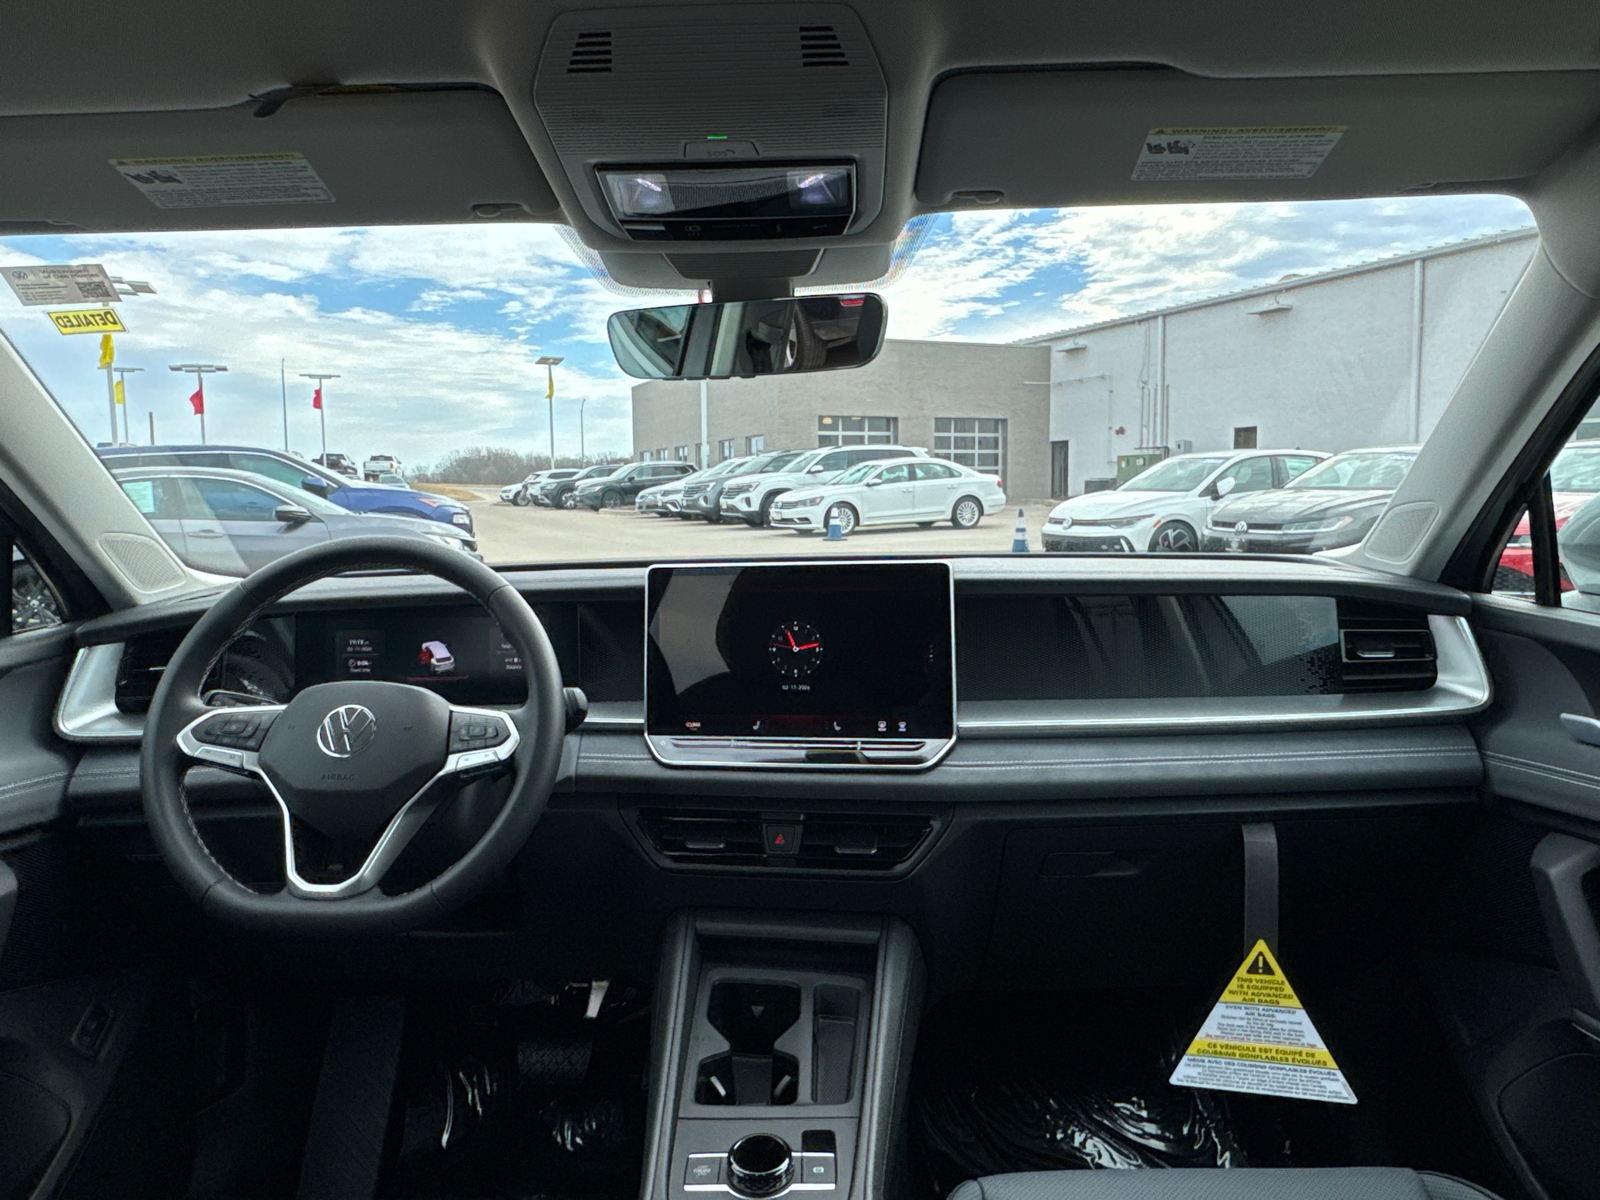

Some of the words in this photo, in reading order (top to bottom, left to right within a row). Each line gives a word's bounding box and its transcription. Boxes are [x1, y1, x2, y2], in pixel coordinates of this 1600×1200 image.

[321, 773, 355, 781] AIRBAG
[1254, 977, 1285, 985] VEHICLE
[1247, 984, 1285, 992] EQUIPPED
[1251, 991, 1294, 999] ADVANCED
[1261, 1007, 1297, 1015] ADVANCED
[1219, 1043, 1257, 1053] VÉHICULE
[1275, 1048, 1303, 1057] ÉQUIPÉ
[1196, 1048, 1237, 1057] COUSSINS
[1239, 1052, 1290, 1062] GONFLABLES
[1291, 1057, 1328, 1066] ÉVOLUÉS
